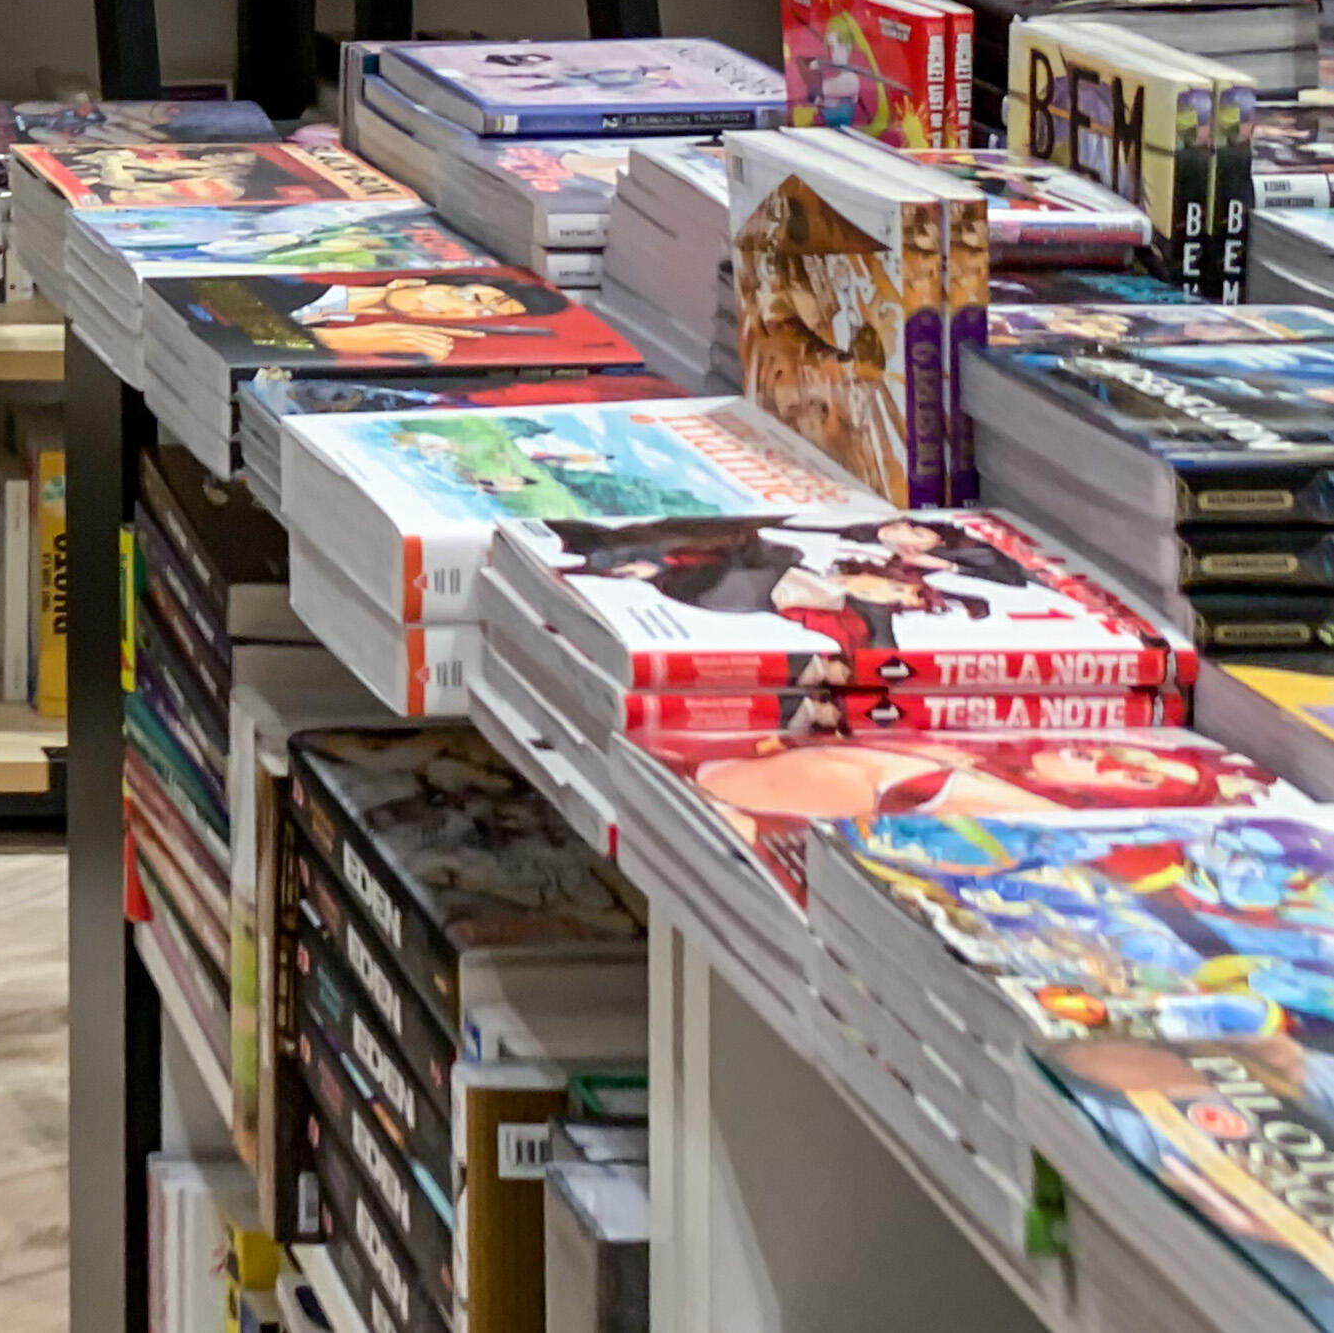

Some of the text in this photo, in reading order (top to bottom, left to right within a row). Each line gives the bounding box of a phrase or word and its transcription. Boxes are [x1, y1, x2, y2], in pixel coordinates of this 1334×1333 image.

[1222, 199, 1244, 305] BEM
[925, 697, 1129, 729] TESLA NOTE
[934, 652, 1140, 686] TESLA NOTE
[344, 839, 402, 950] EDEN
[347, 922, 402, 1037] EDEN
[353, 1011, 415, 1130] EDEN
[352, 1109, 410, 1233] EDEN
[356, 1194, 409, 1324] EDEN
